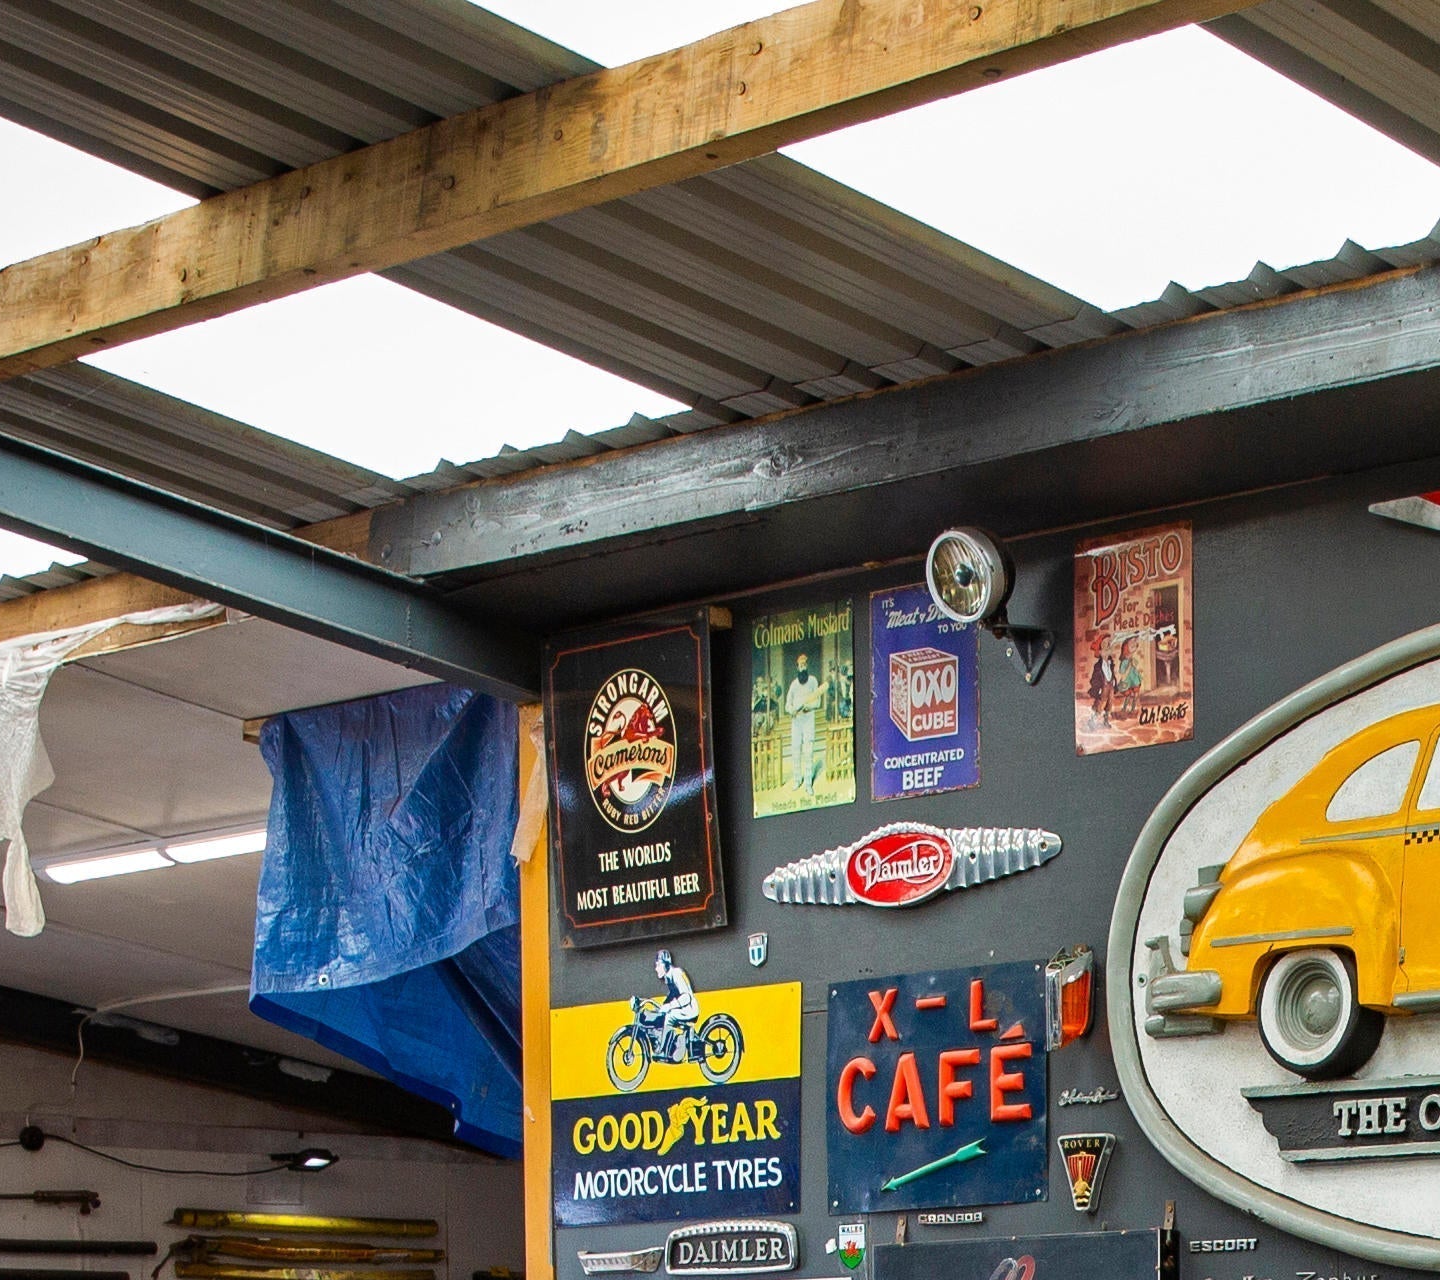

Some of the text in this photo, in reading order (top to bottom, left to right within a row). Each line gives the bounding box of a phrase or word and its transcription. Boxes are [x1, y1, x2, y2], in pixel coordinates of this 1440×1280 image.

[1092, 534, 1184, 628] BISTO
[911, 664, 957, 708] OXO
[590, 673, 669, 737] STRONGARM
[912, 707, 954, 730] CUBE
[593, 745, 667, 775] Camerons
[884, 747, 964, 770] CONCENTRATED
[902, 766, 944, 791] BEEF
[598, 842, 671, 873] THE WORLDS
[859, 842, 944, 891] Daimler
[577, 873, 699, 911] MOST BEAUTIFUL BEER
[1332, 1092, 1409, 1139] THE
[1064, 1139, 1101, 1149] ROVER
[573, 1157, 783, 1200] MOTORCYCLE TYRES
[678, 1237, 784, 1265] DAIMLER
[1190, 1239, 1257, 1252] ESCORT
